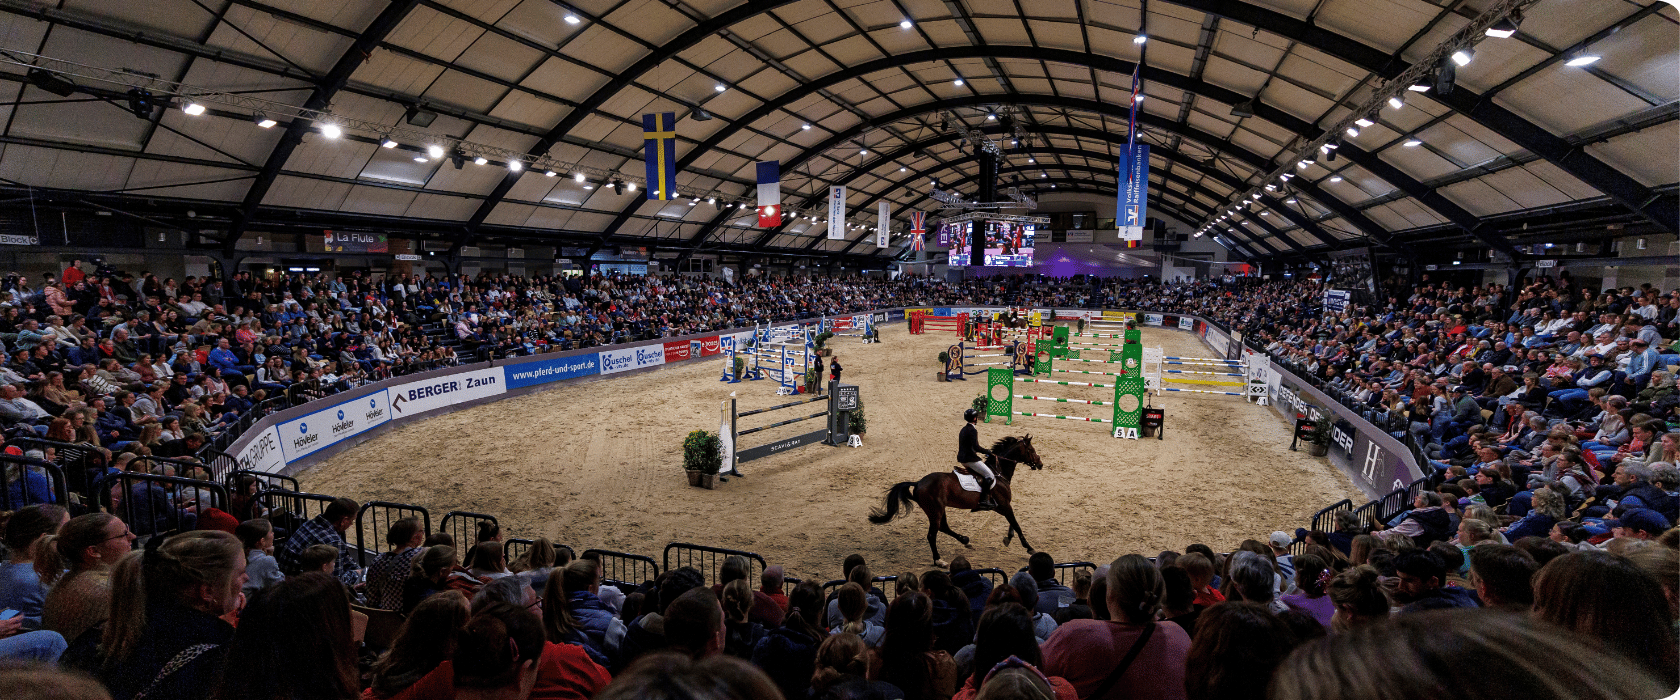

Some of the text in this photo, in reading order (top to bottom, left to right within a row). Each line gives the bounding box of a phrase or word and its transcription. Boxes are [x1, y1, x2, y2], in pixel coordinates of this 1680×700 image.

[1, 236, 28, 244] Block
[336, 233, 374, 243] La Flute
[512, 359, 595, 381] www.pferd-und-sport.de
[408, 381, 458, 401] BERGER
[465, 376, 496, 389] Zaun
[1279, 385, 1308, 415] DEFENDER
[293, 433, 318, 449] Höveler
[1117, 429, 1135, 438] 5 A
